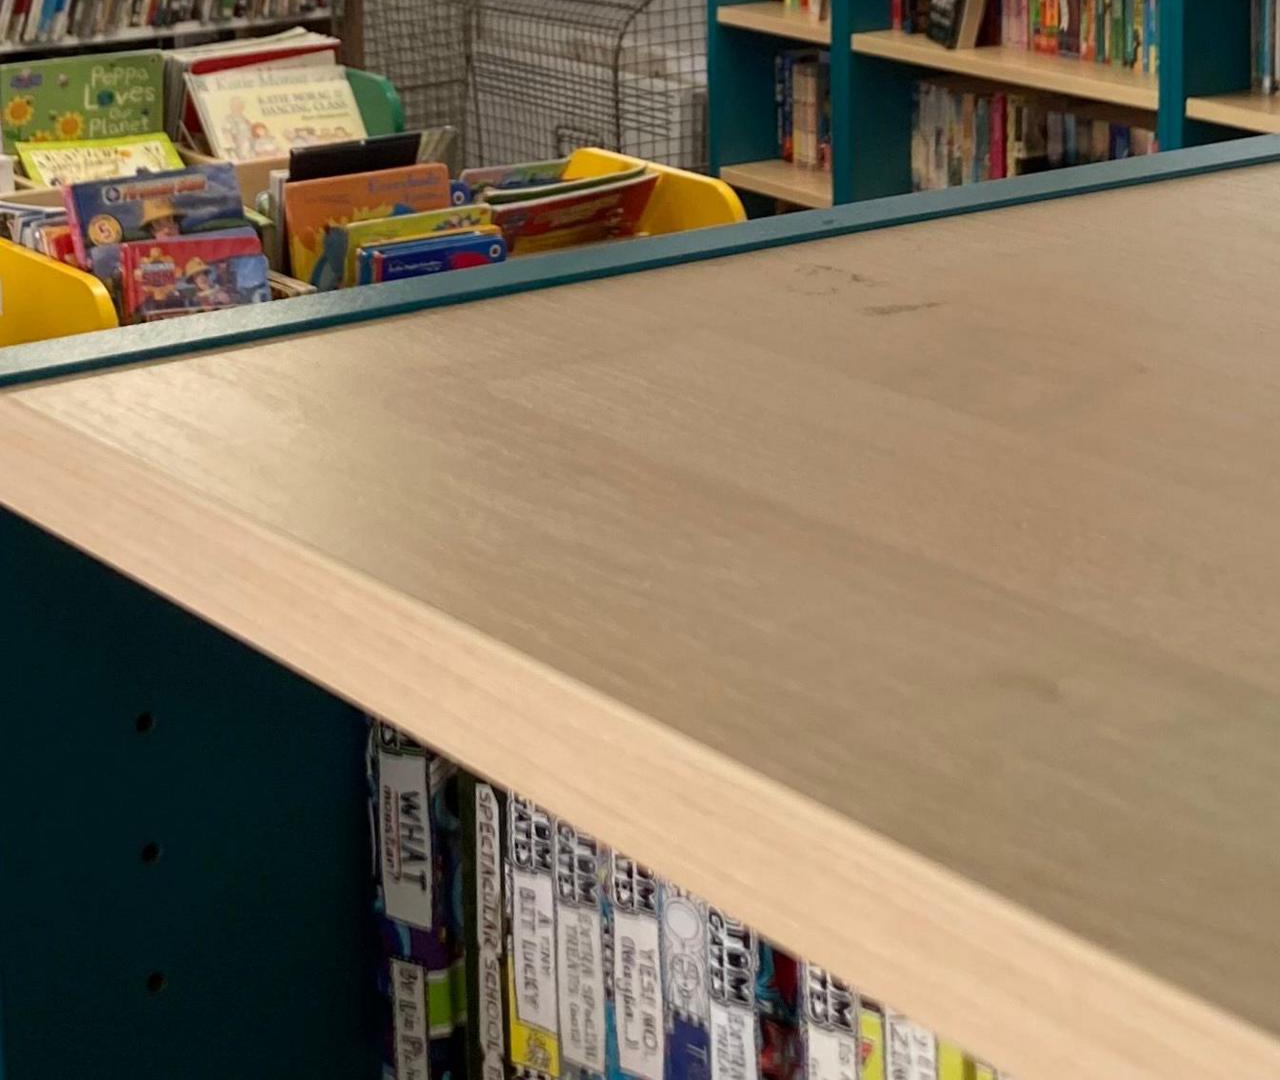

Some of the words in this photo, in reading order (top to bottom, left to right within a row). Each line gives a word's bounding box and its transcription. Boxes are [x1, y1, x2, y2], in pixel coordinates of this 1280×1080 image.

[91, 64, 150, 88] Peppa
[88, 116, 151, 139] Planet
[399, 790, 428, 893] WHAT
[478, 791, 502, 949] SPECTACULAR
[556, 822, 578, 903] GATES
[576, 836, 599, 906] TOM
[518, 887, 537, 934] BIT
[536, 910, 551, 929] A
[520, 938, 539, 1010] LUCKY
[709, 908, 725, 1002] GATES
[724, 926, 751, 1004] TOM
[483, 958, 503, 1052] SCHOOL
